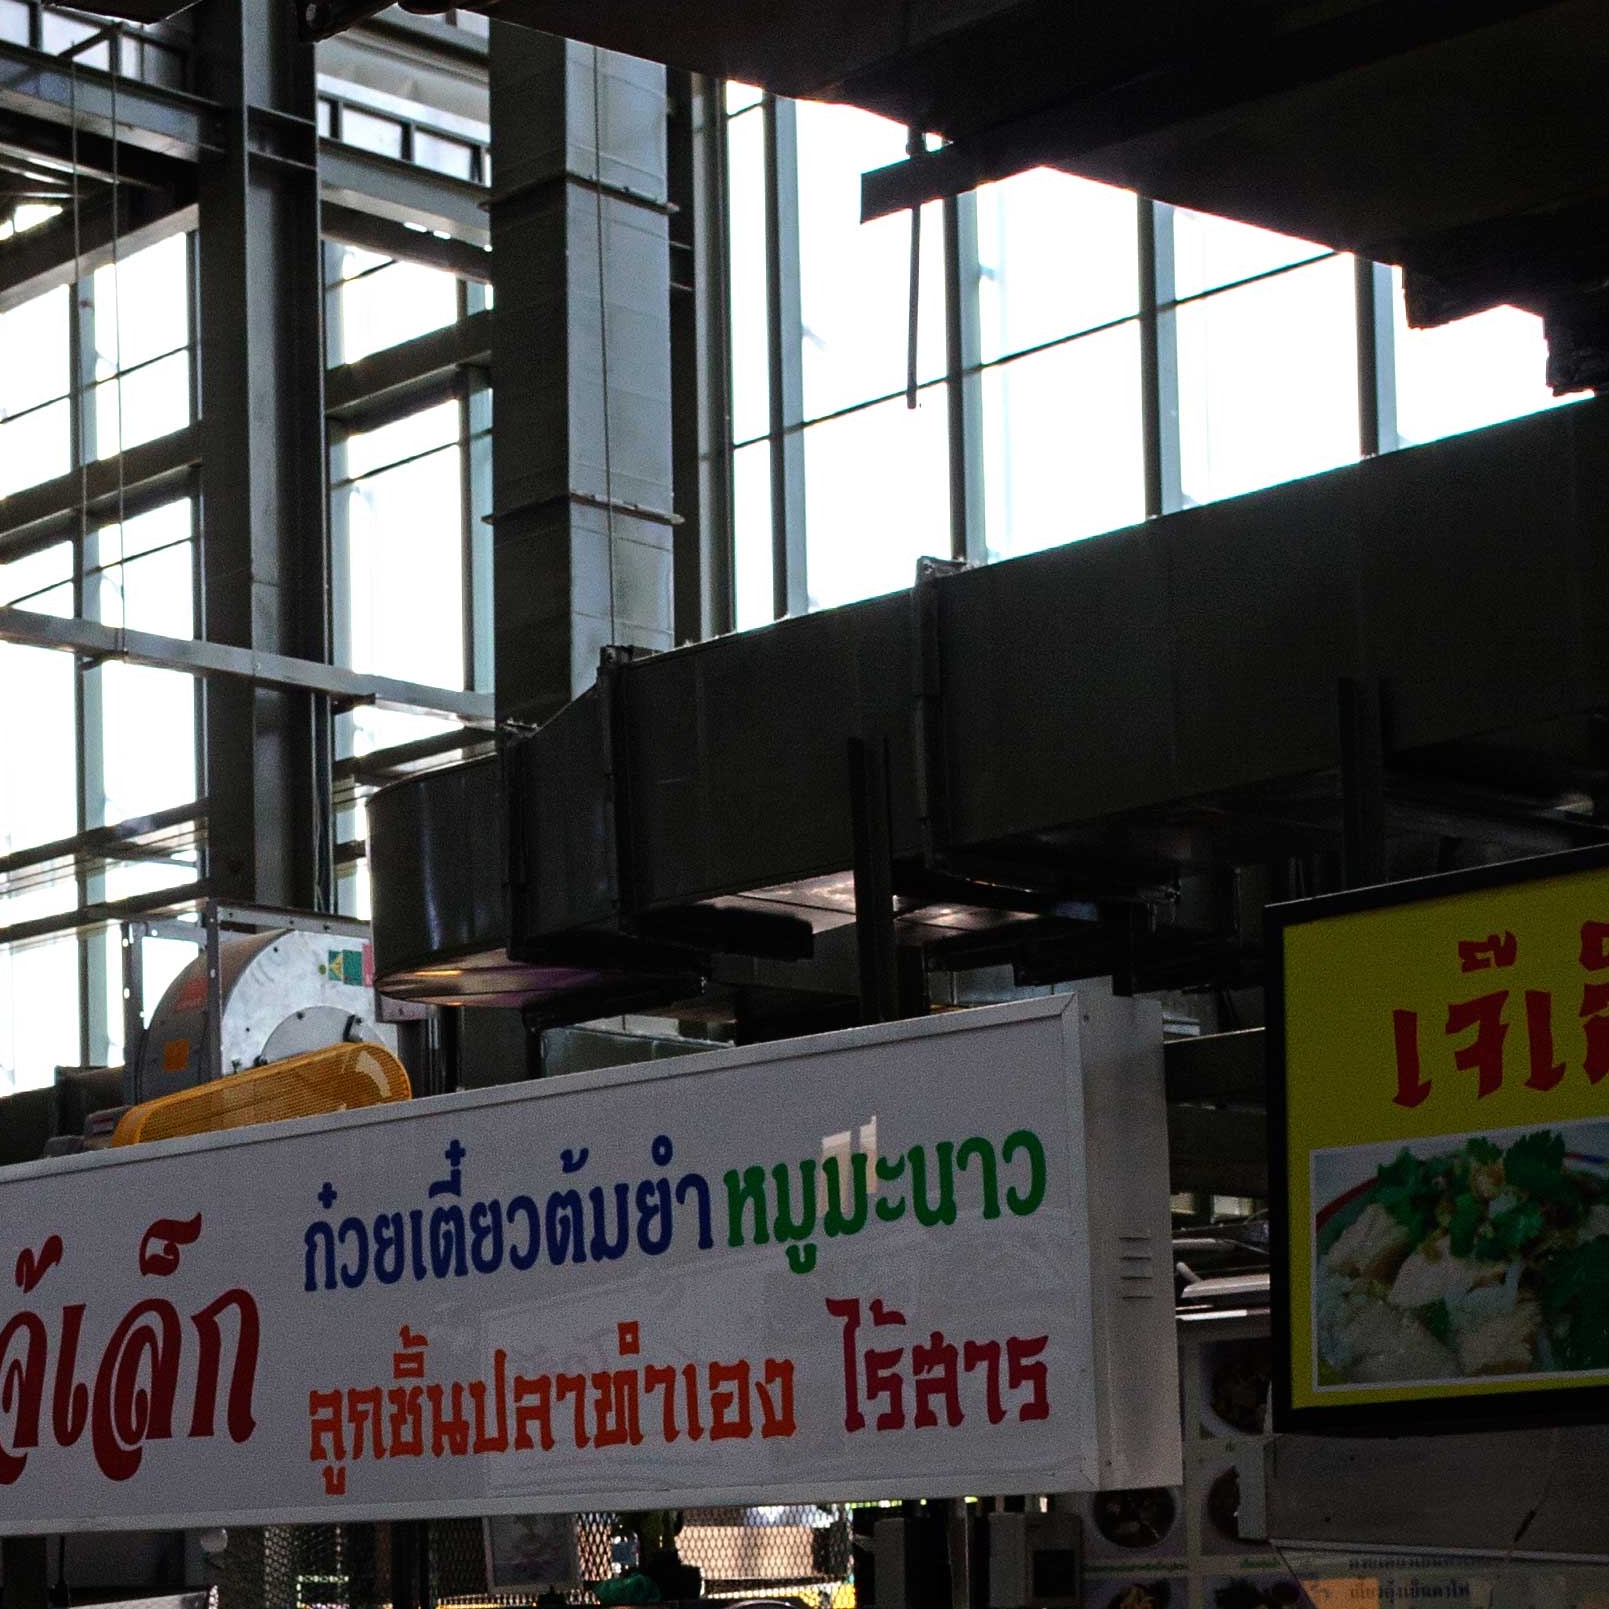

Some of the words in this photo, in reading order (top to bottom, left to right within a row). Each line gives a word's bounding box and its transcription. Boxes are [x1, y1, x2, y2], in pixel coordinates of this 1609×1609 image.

[308, 1320, 797, 1496] ลูกชิ้นปลาทำเอง
[825, 1297, 1050, 1433] ไร้สาร
